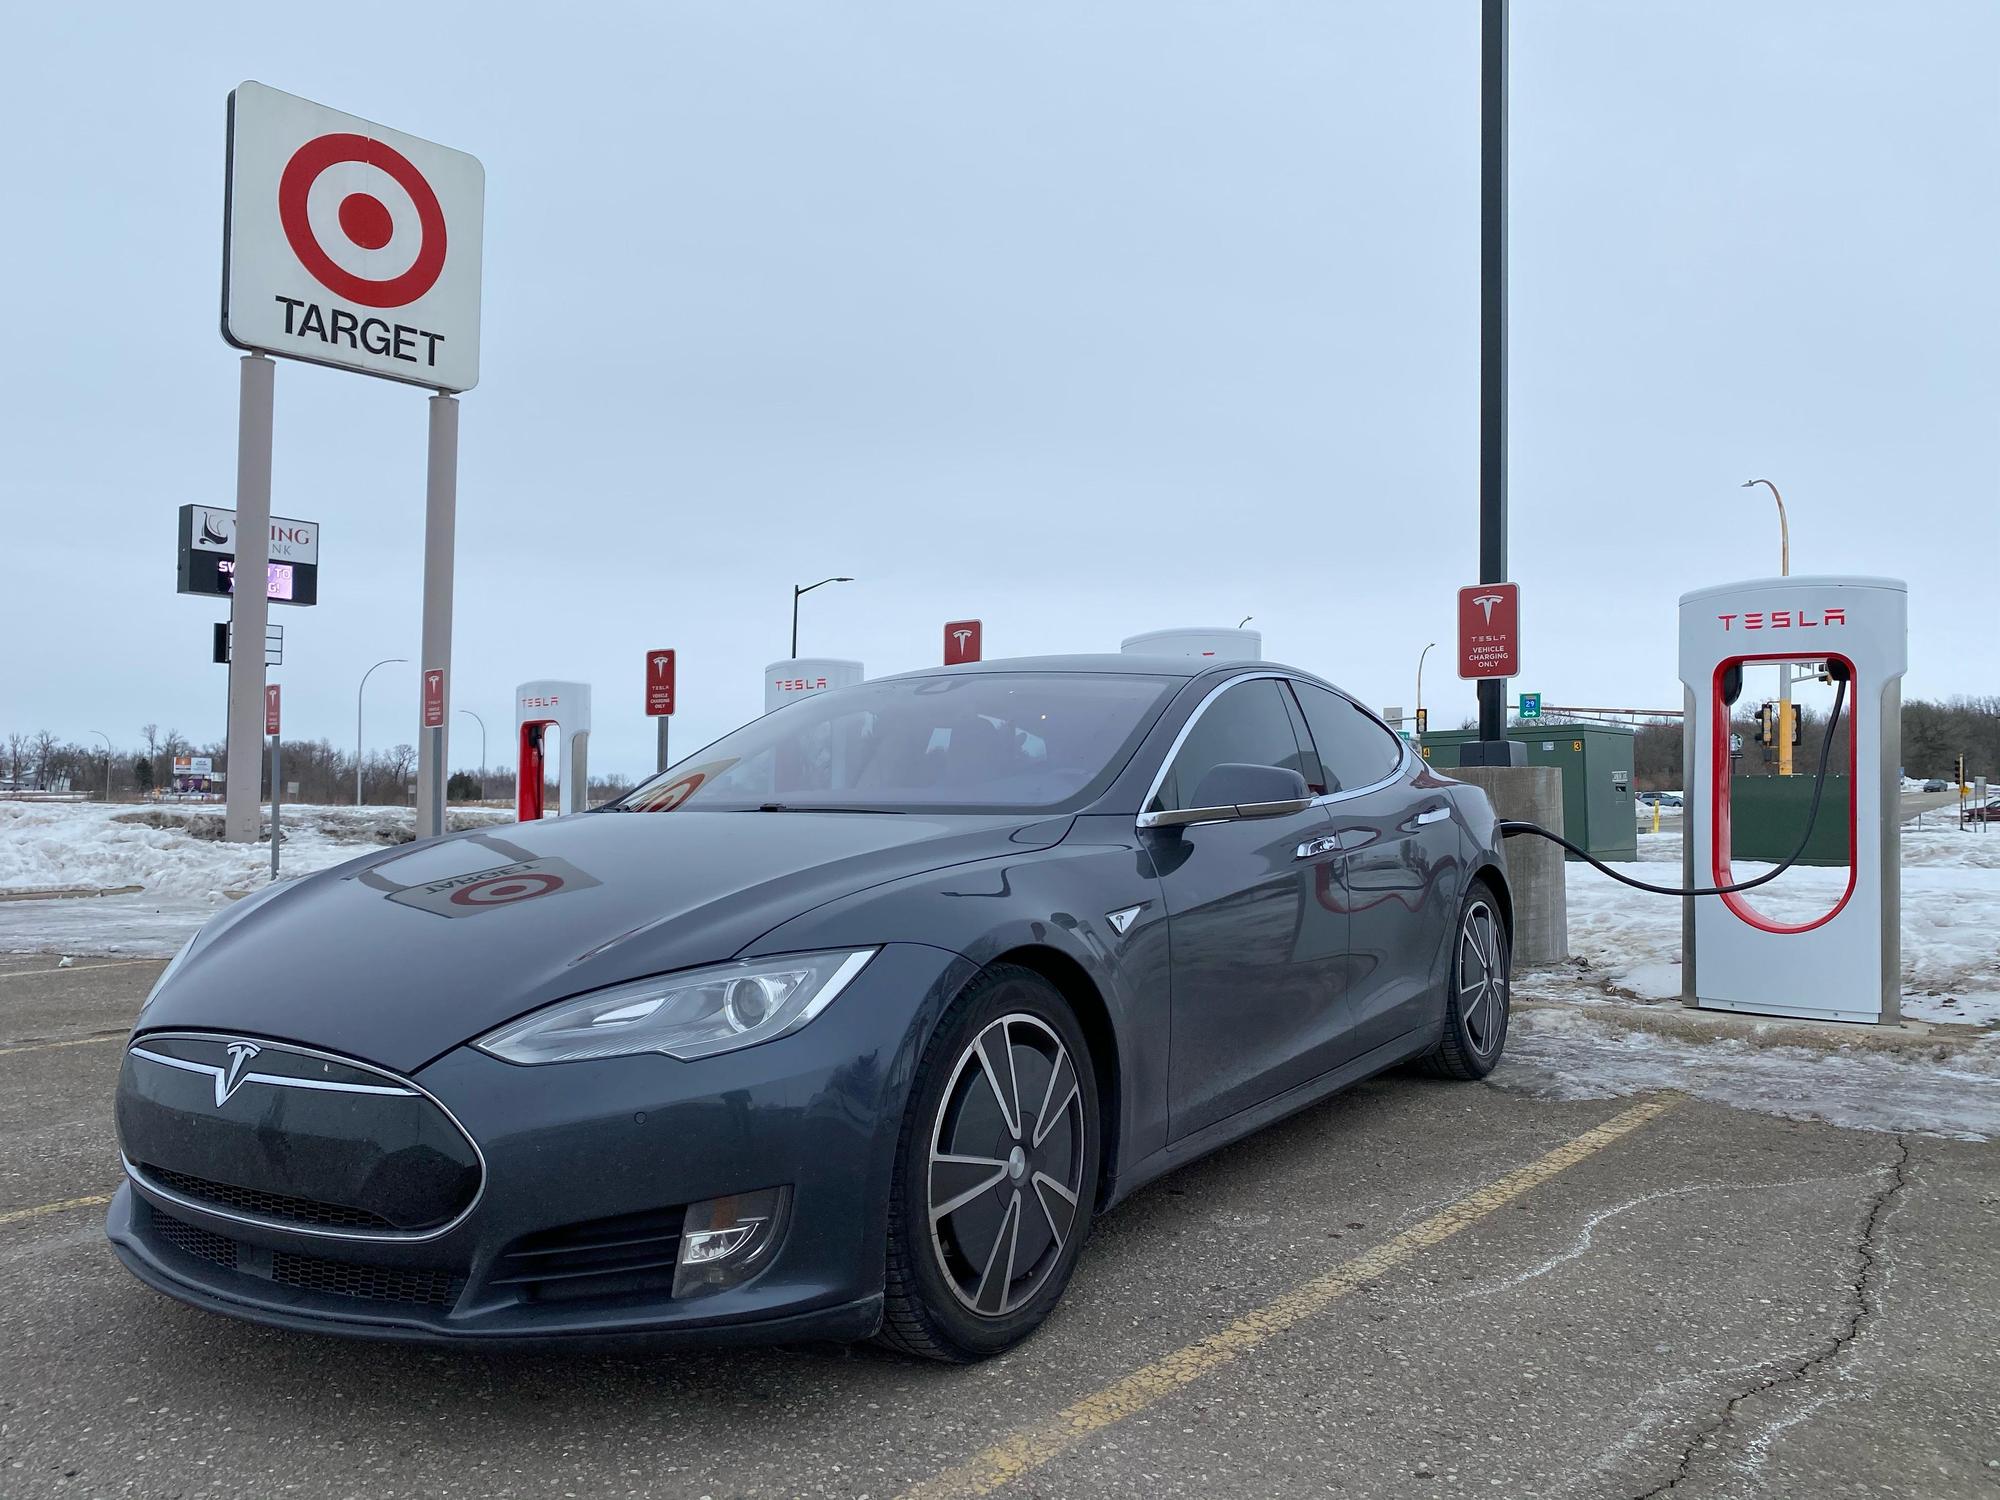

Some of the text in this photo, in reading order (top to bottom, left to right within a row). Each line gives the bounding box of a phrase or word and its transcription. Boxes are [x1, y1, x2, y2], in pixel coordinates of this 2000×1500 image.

[275, 295, 445, 367] TARGET
[1717, 608, 1845, 631] TESLA
[1471, 634, 1507, 643] TESLA
[1472, 645, 1505, 654] VEHICLE
[1468, 652, 1509, 661] CHARGING
[1478, 660, 1499, 668] ONLY
[775, 678, 827, 691] TESLA
[521, 696, 559, 708] TESLA
[1525, 700, 1535, 708] 29
